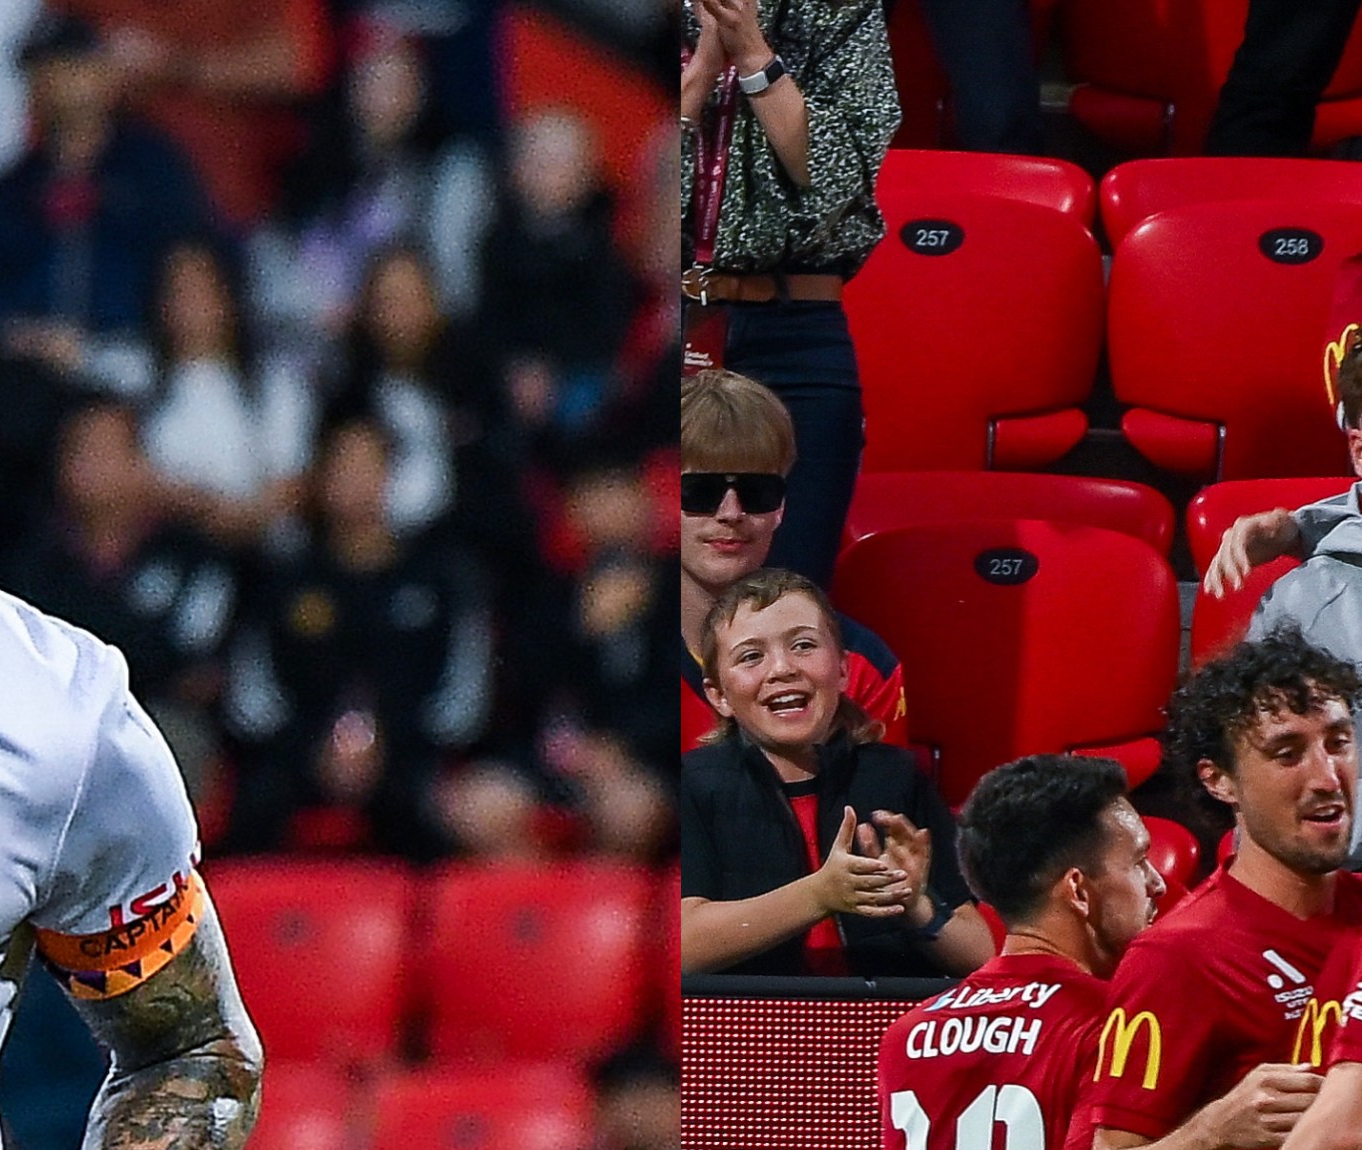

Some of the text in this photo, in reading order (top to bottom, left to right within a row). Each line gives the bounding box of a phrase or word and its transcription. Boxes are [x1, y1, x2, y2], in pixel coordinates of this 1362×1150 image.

[916, 228, 949, 247] 257
[1275, 237, 1308, 256] 258
[989, 557, 1023, 576] 257
[950, 981, 1062, 1009] Liberty
[906, 1016, 1043, 1059] CLOUGH
